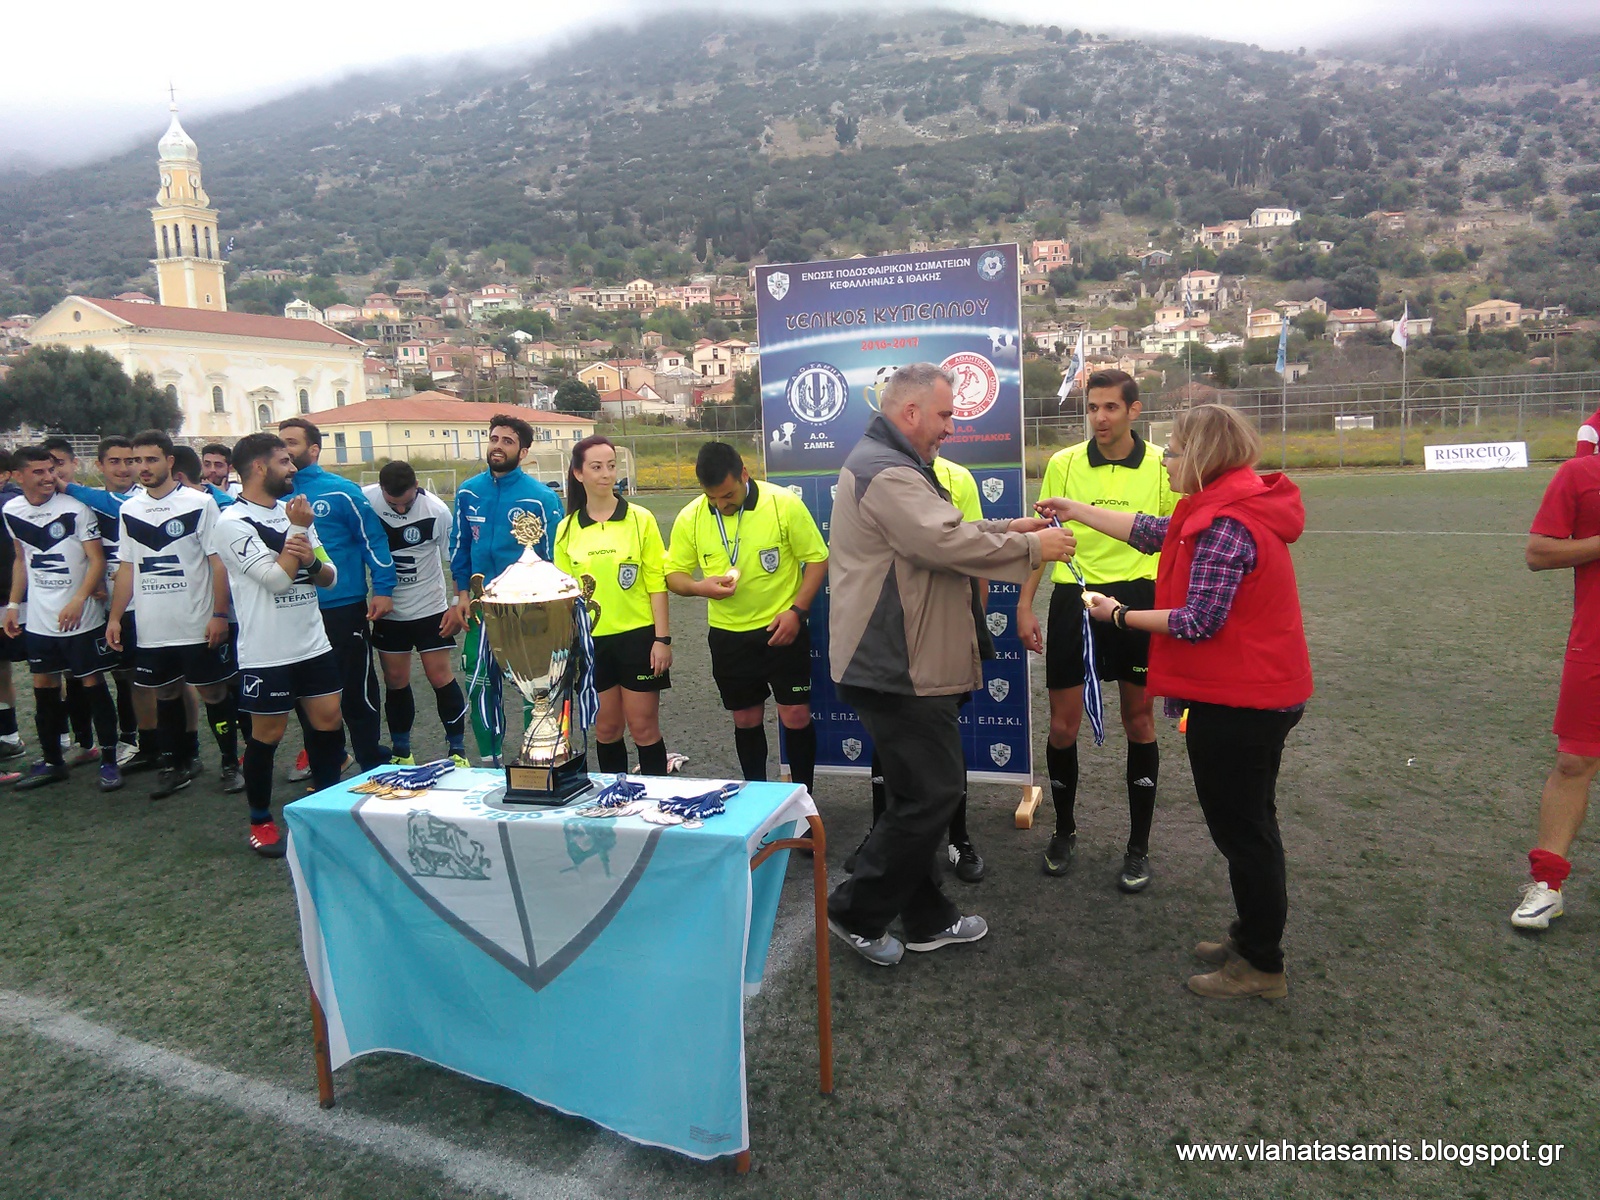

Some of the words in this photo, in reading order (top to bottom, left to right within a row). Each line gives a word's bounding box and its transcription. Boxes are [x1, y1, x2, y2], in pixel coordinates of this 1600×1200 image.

[801, 269, 834, 281] ΕΝΩΣΙΣ
[836, 263, 913, 278] ΠΟΔΟΣΦΑΙΡΙΚΩΝ
[915, 258, 971, 271] ΣΩΜΑΤΕΙΩΝ
[829, 276, 895, 290] ΚΕΦΑΛΛΗΝΙΑΣ
[897, 275, 904, 284] &
[906, 272, 942, 283] ΙΘΑΚΗΣ
[810, 432, 828, 440] Α.Ο.
[804, 442, 835, 450] ΣΑΜΗΣ
[141, 582, 188, 591] STEFATOU
